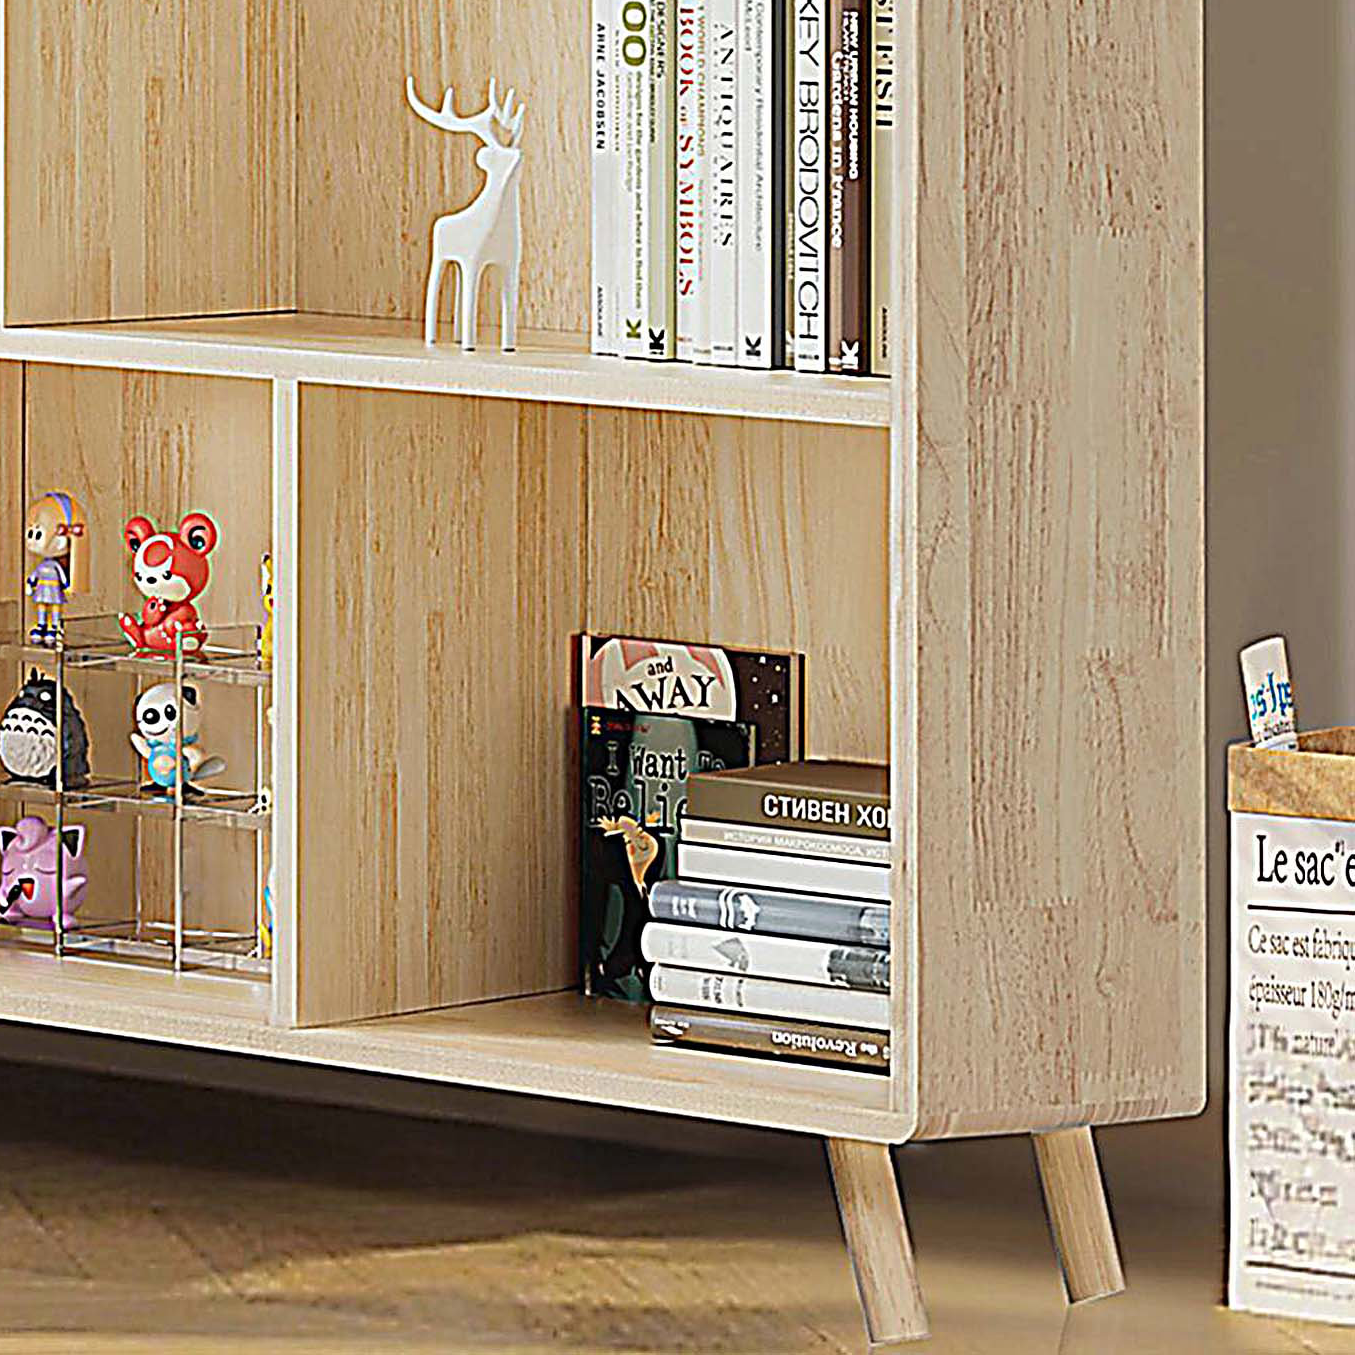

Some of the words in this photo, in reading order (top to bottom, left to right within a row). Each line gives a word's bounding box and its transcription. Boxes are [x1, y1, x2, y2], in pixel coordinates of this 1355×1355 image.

[596, 23, 605, 62] ARNE
[680, 8, 694, 96] BOOK
[596, 69, 605, 149] JACOBSEN
[718, 24, 734, 247] ANTIQUAIRES
[679, 134, 694, 295] SYMBOLS
[799, 82, 819, 339] BRODOVITCH
[647, 656, 674, 676] and
[616, 674, 716, 711] AWAY
[629, 744, 688, 781] Want
[764, 794, 850, 825] СТИВЕН
[1256, 834, 1288, 884] Le
[1248, 924, 1267, 954] Ce
[1270, 934, 1290, 956] sac
[1292, 935, 1310, 958] est
[771, 1031, 857, 1057] Revolution
